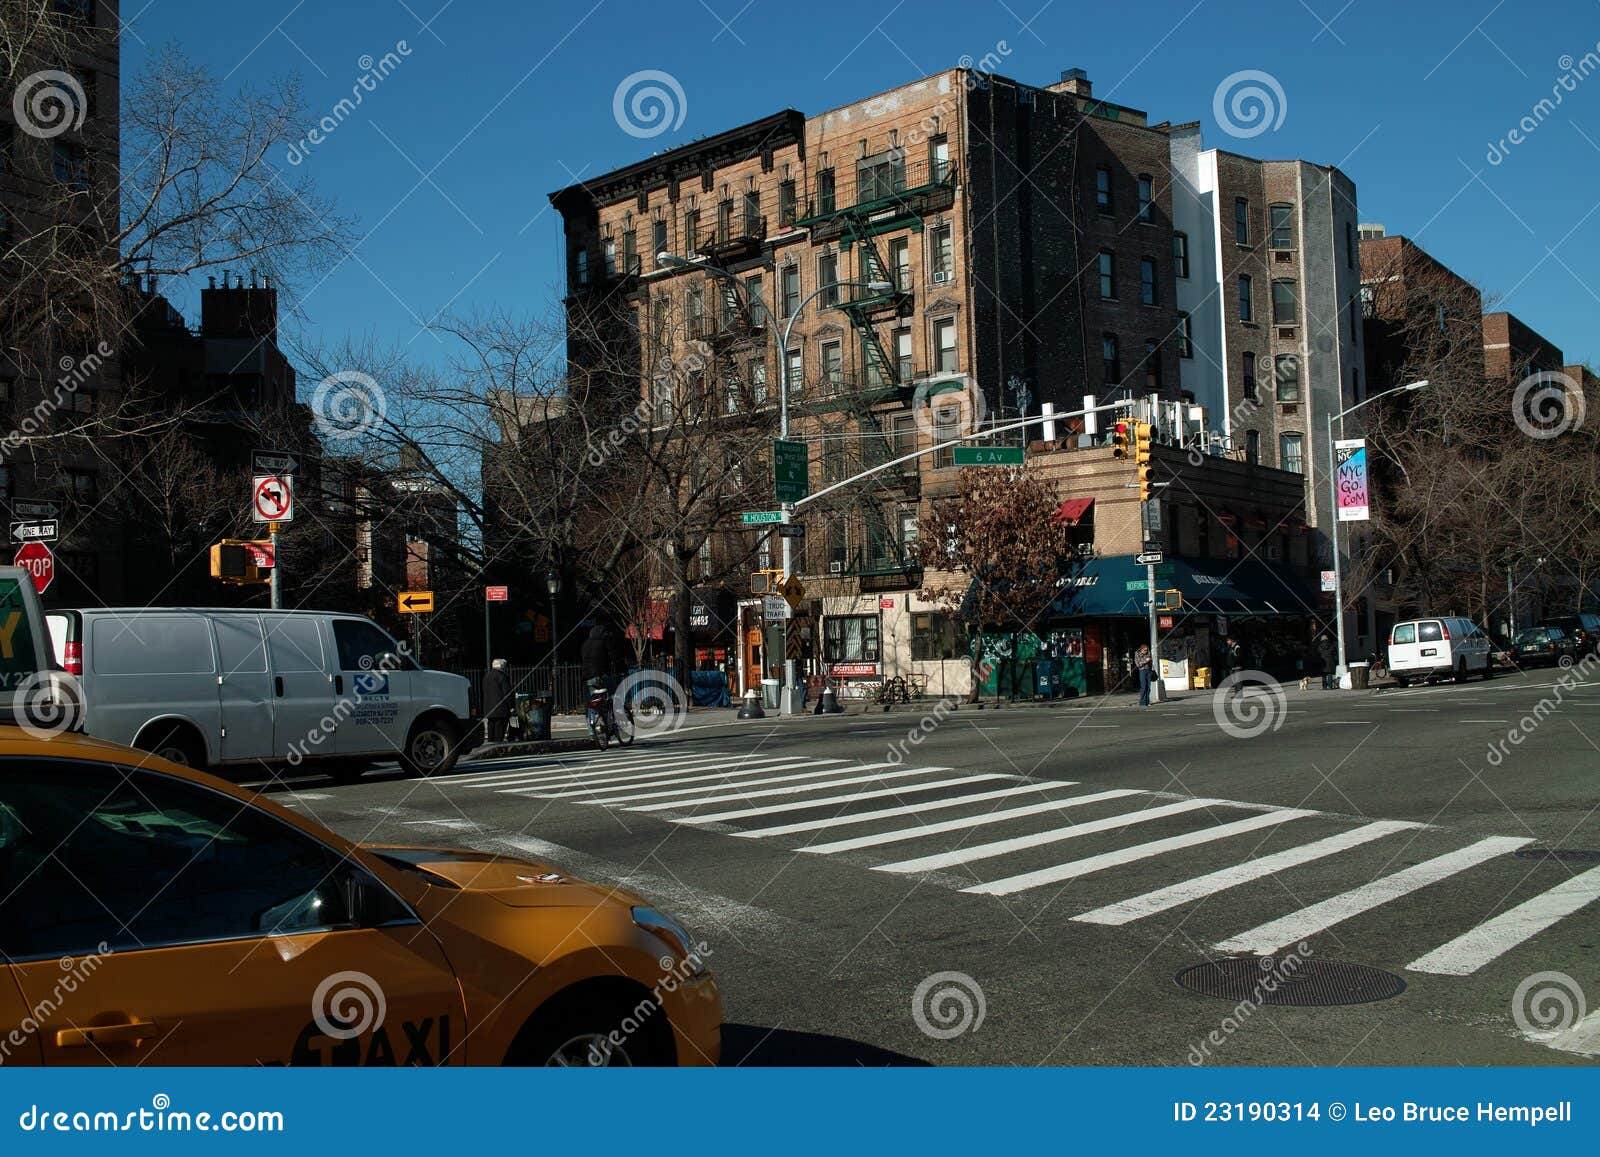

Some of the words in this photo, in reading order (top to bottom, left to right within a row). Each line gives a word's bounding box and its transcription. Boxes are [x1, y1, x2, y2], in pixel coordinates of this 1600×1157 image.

[976, 452, 983, 462] 6
[988, 452, 1003, 462] Av
[1339, 464, 1363, 480] NYC
[750, 512, 777, 522] HOUSTON
[22, 528, 36, 537] ONE
[39, 526, 52, 536] WAY
[306, 1013, 450, 1067] TAXI
